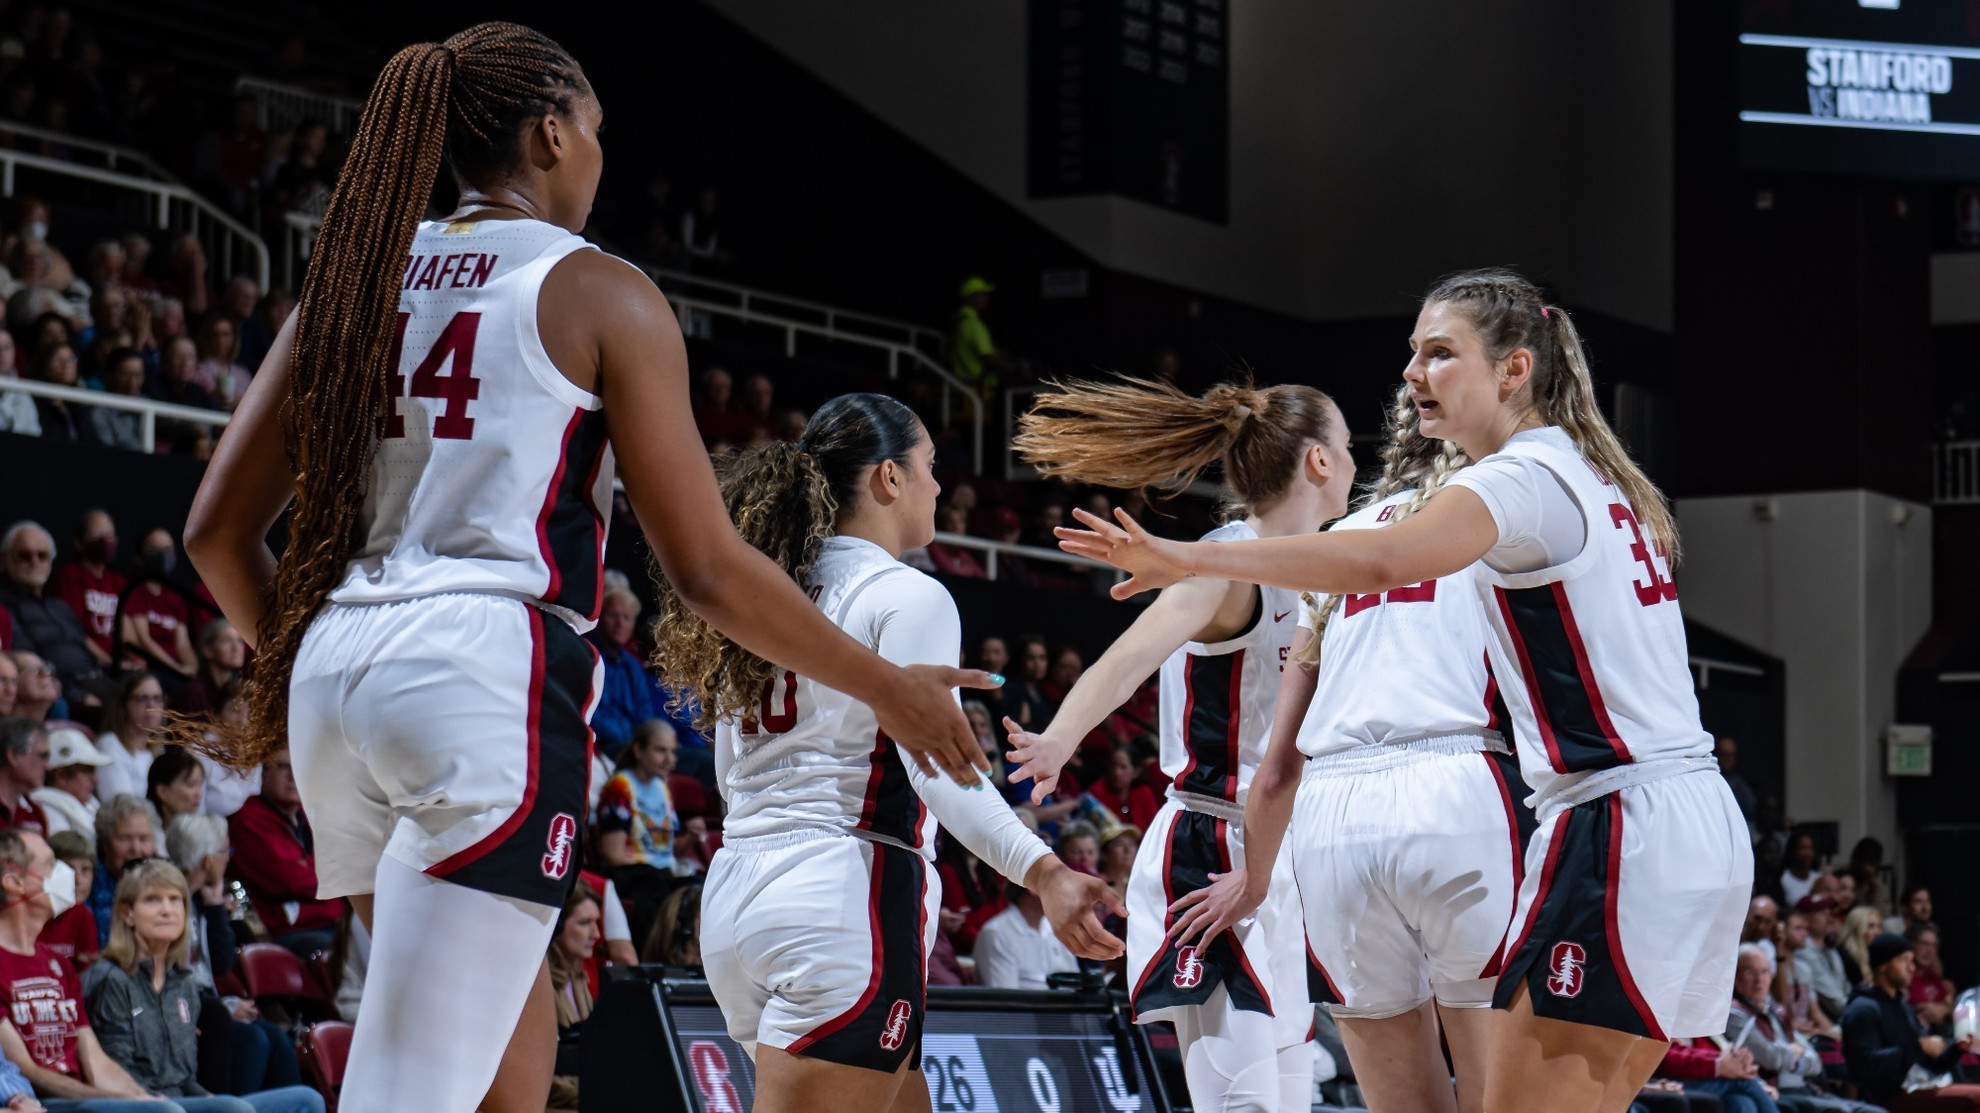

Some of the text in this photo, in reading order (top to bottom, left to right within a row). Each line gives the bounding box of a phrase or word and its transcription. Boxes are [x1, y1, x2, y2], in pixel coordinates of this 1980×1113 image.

[1806, 48, 1952, 94] STANFORD
[1808, 86, 1932, 124] VS INDIANA
[741, 669, 798, 735] 0
[925, 1055, 976, 1112] 26
[1026, 1057, 1061, 1113] 0
